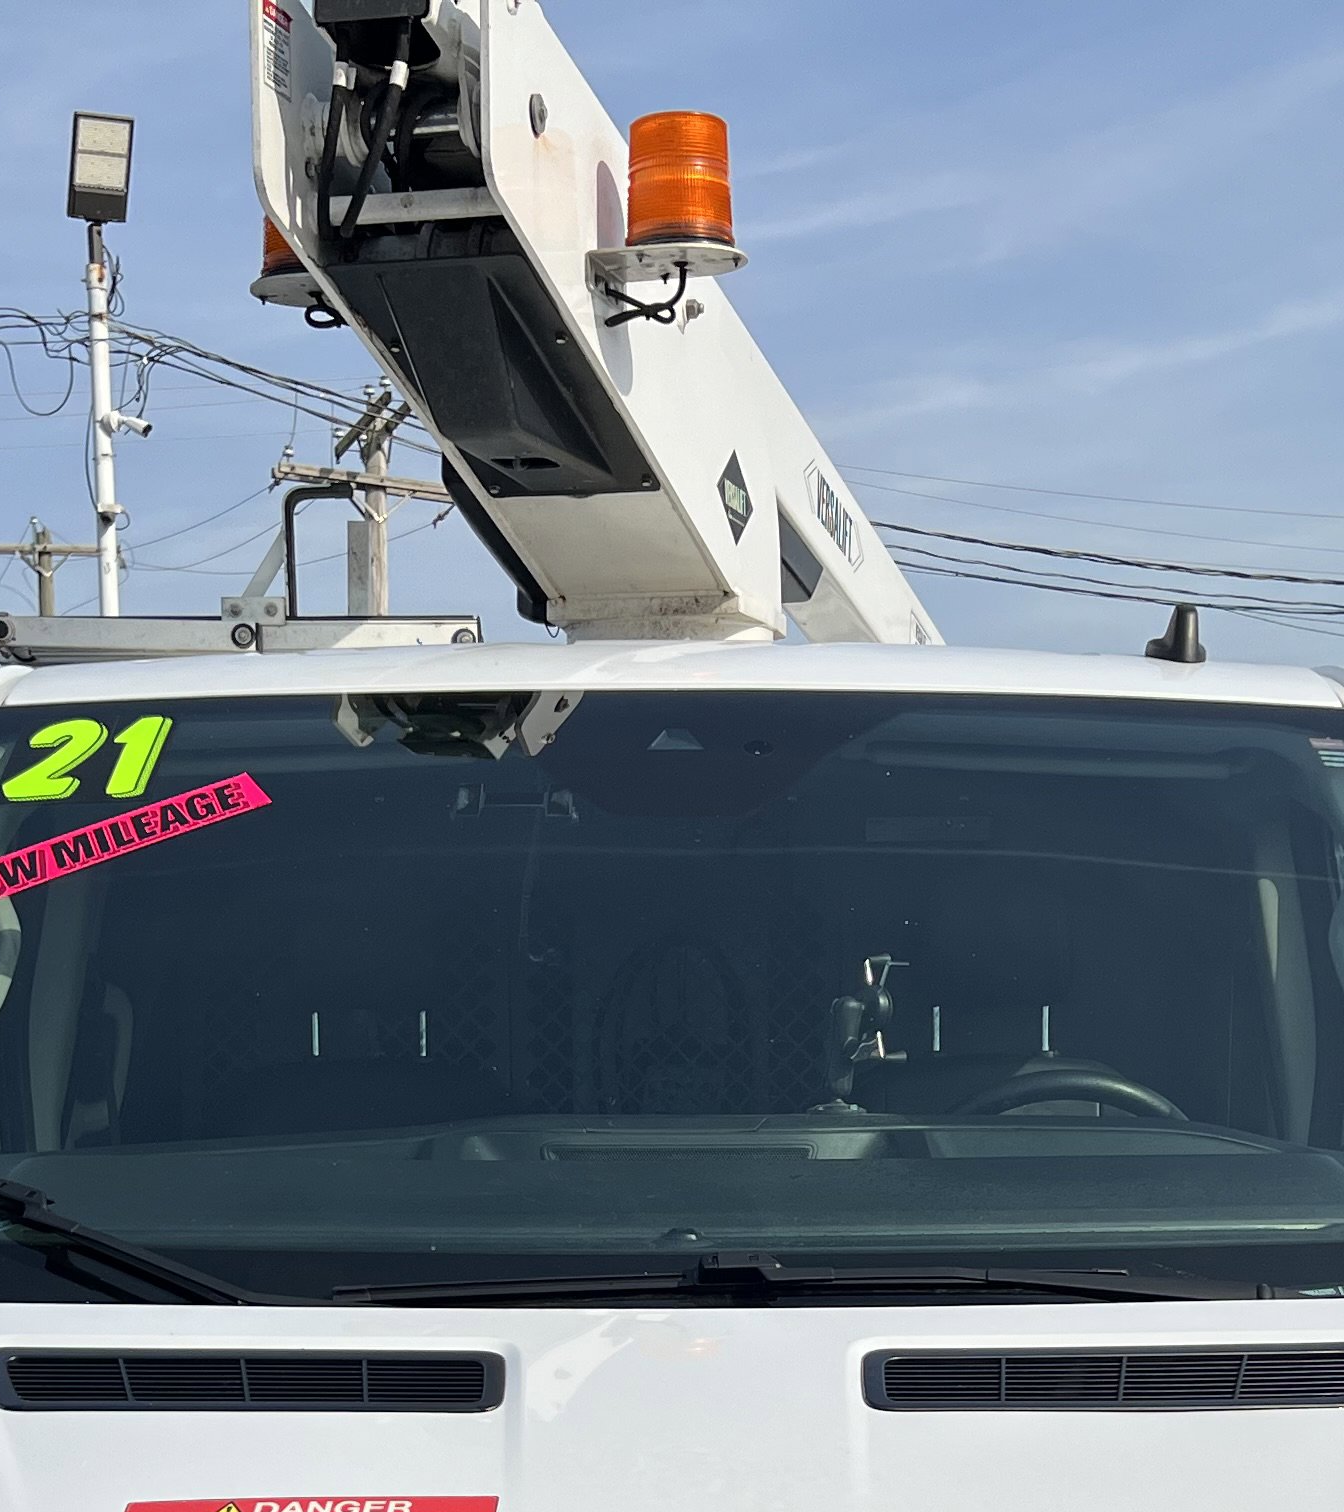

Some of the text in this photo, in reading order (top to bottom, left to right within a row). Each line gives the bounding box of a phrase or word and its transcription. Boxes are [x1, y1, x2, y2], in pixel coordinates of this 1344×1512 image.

[816, 469, 854, 564] VERSALIFT
[1, 714, 174, 803] 21
[52, 782, 248, 876] MILEAGE
